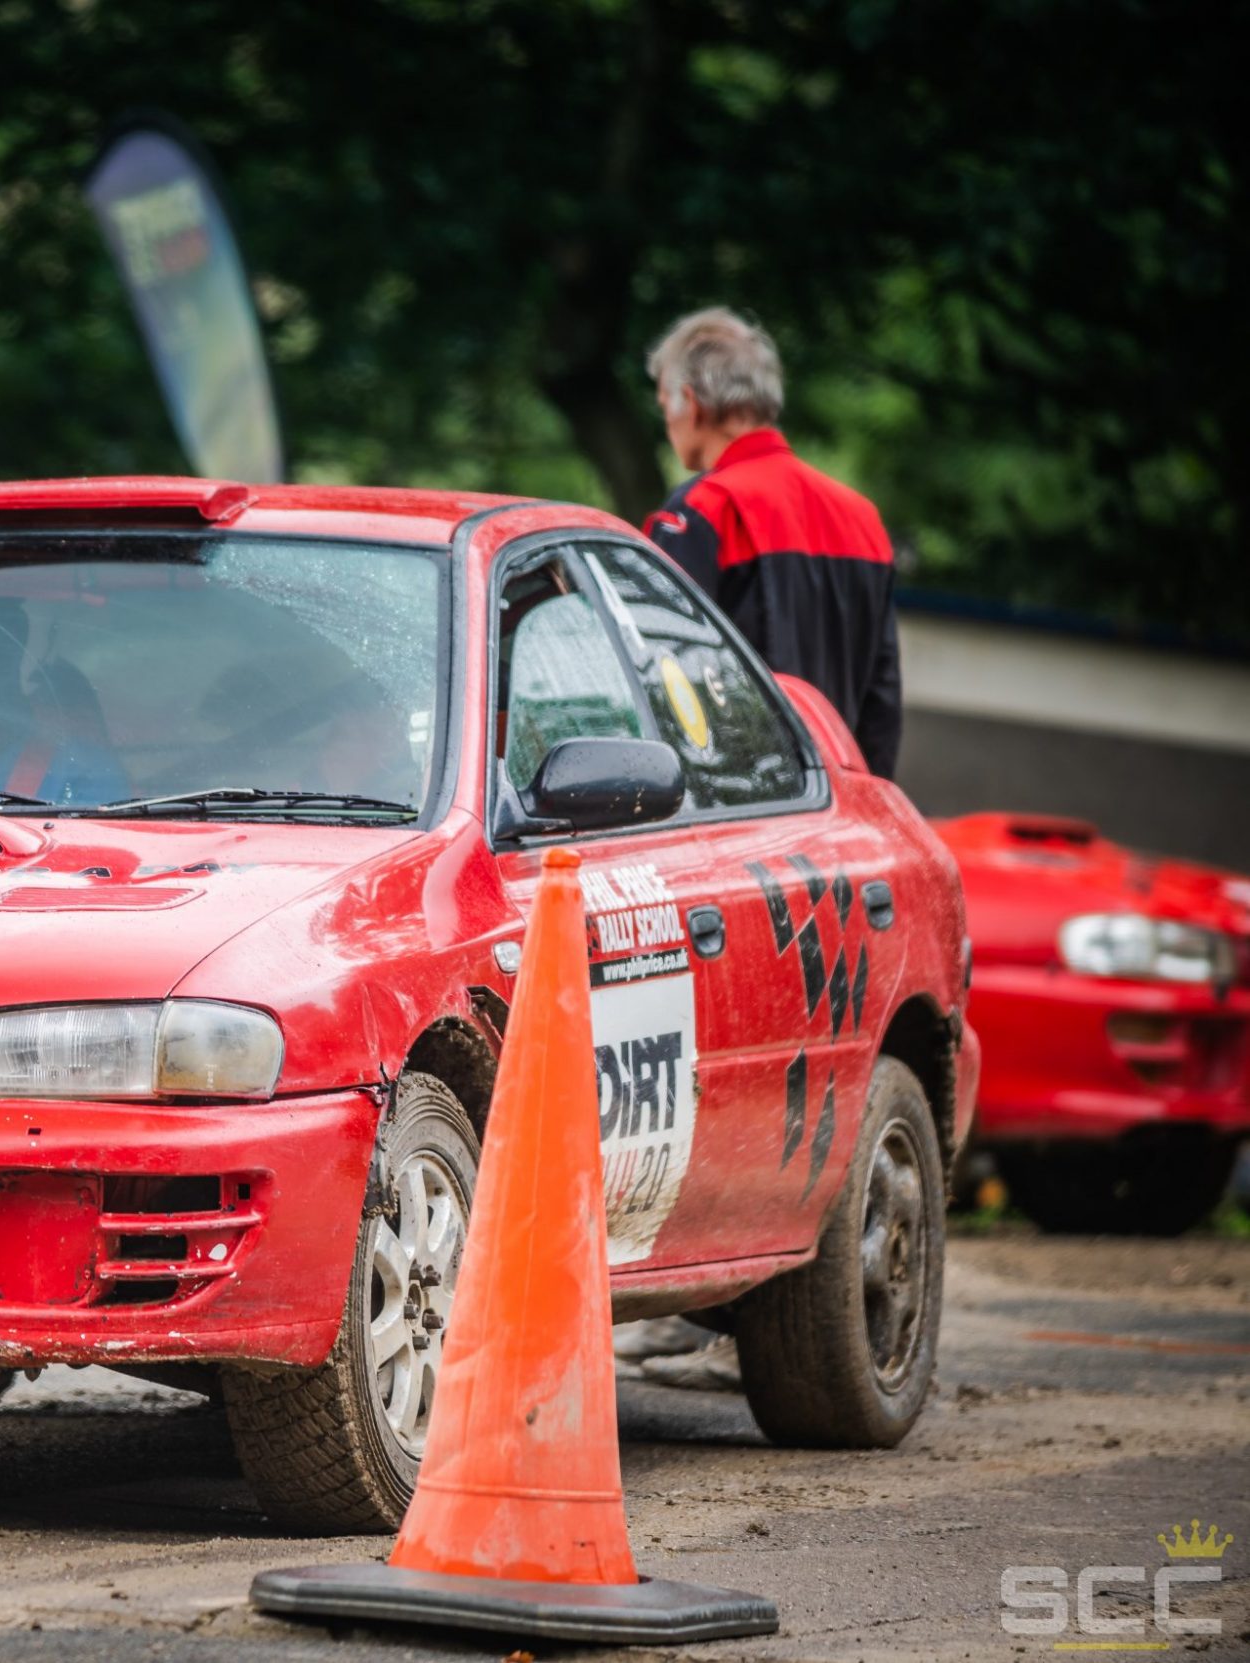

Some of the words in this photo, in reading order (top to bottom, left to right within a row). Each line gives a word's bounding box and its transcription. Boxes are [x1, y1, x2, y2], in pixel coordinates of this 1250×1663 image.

[72, 866, 111, 878] A
[611, 863, 675, 907] PRICE
[596, 911, 635, 954] RALLY
[634, 903, 685, 948] SCHOOL
